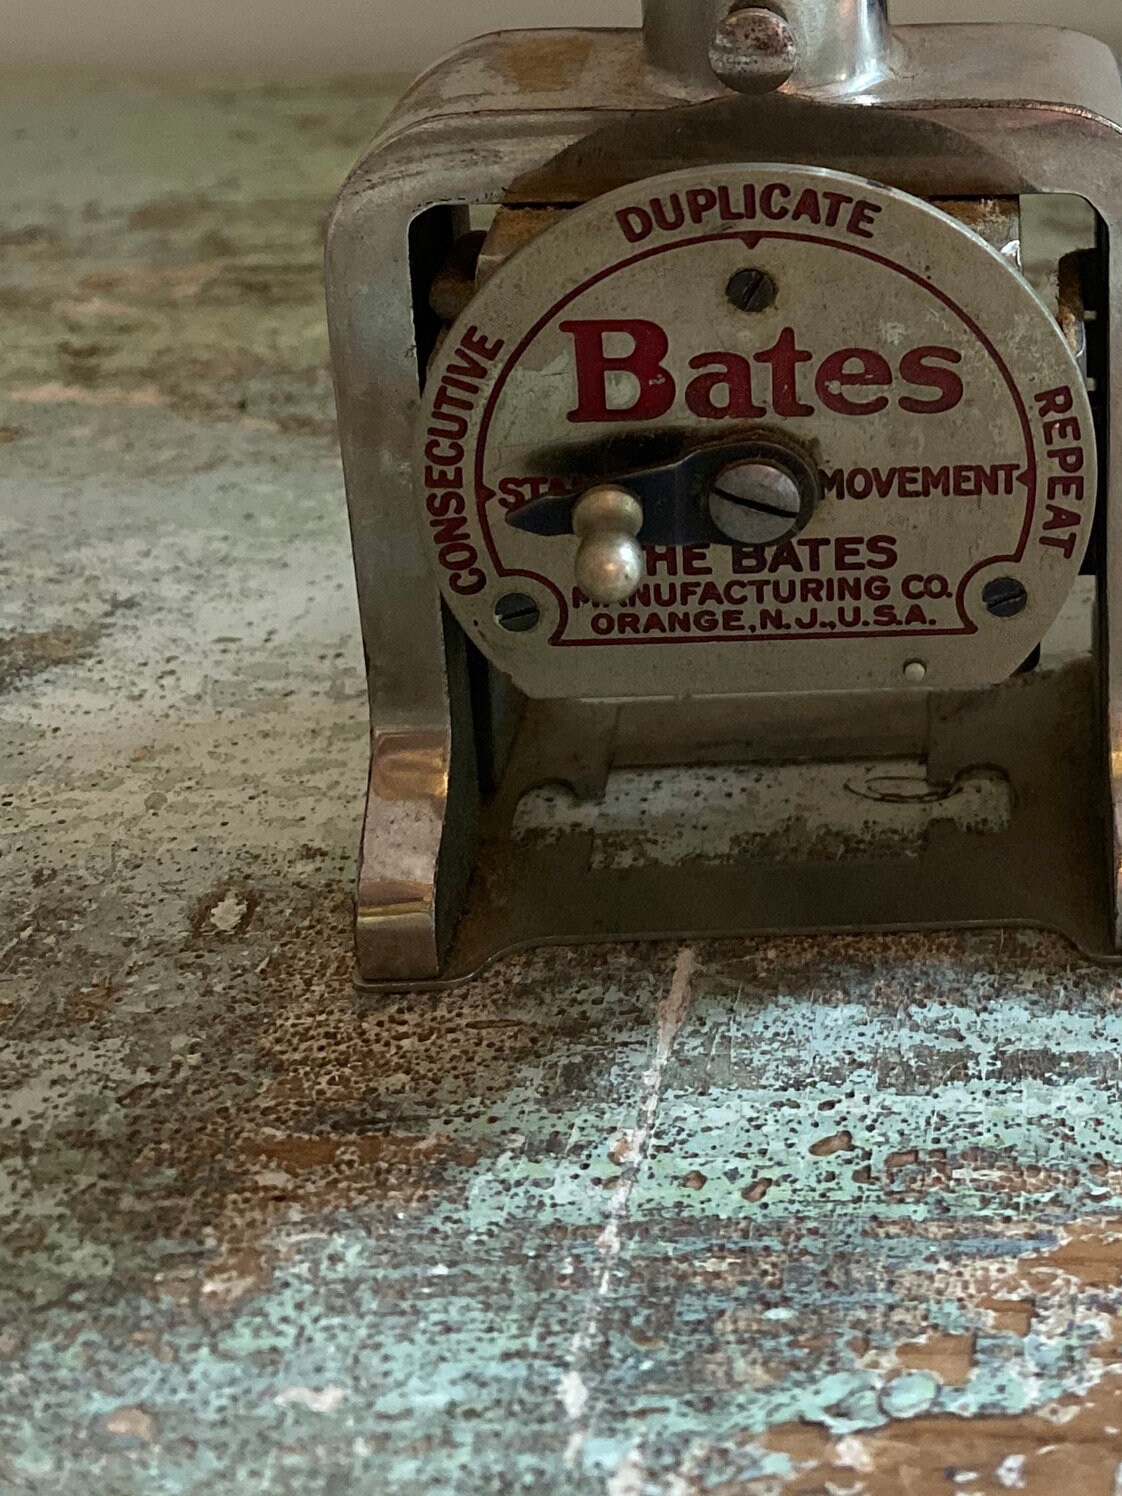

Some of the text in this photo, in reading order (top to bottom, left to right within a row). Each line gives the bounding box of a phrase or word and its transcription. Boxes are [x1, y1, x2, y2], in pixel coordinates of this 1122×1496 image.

[616, 182, 883, 243] DUPLICATE
[558, 318, 963, 424] Bates
[424, 325, 505, 596] CONSECUTIVE
[817, 463, 1021, 500] MOVEMENT
[1034, 386, 1087, 560] REPEAT
[640, 535, 898, 577] HE BATES
[901, 573, 953, 600] CO.
